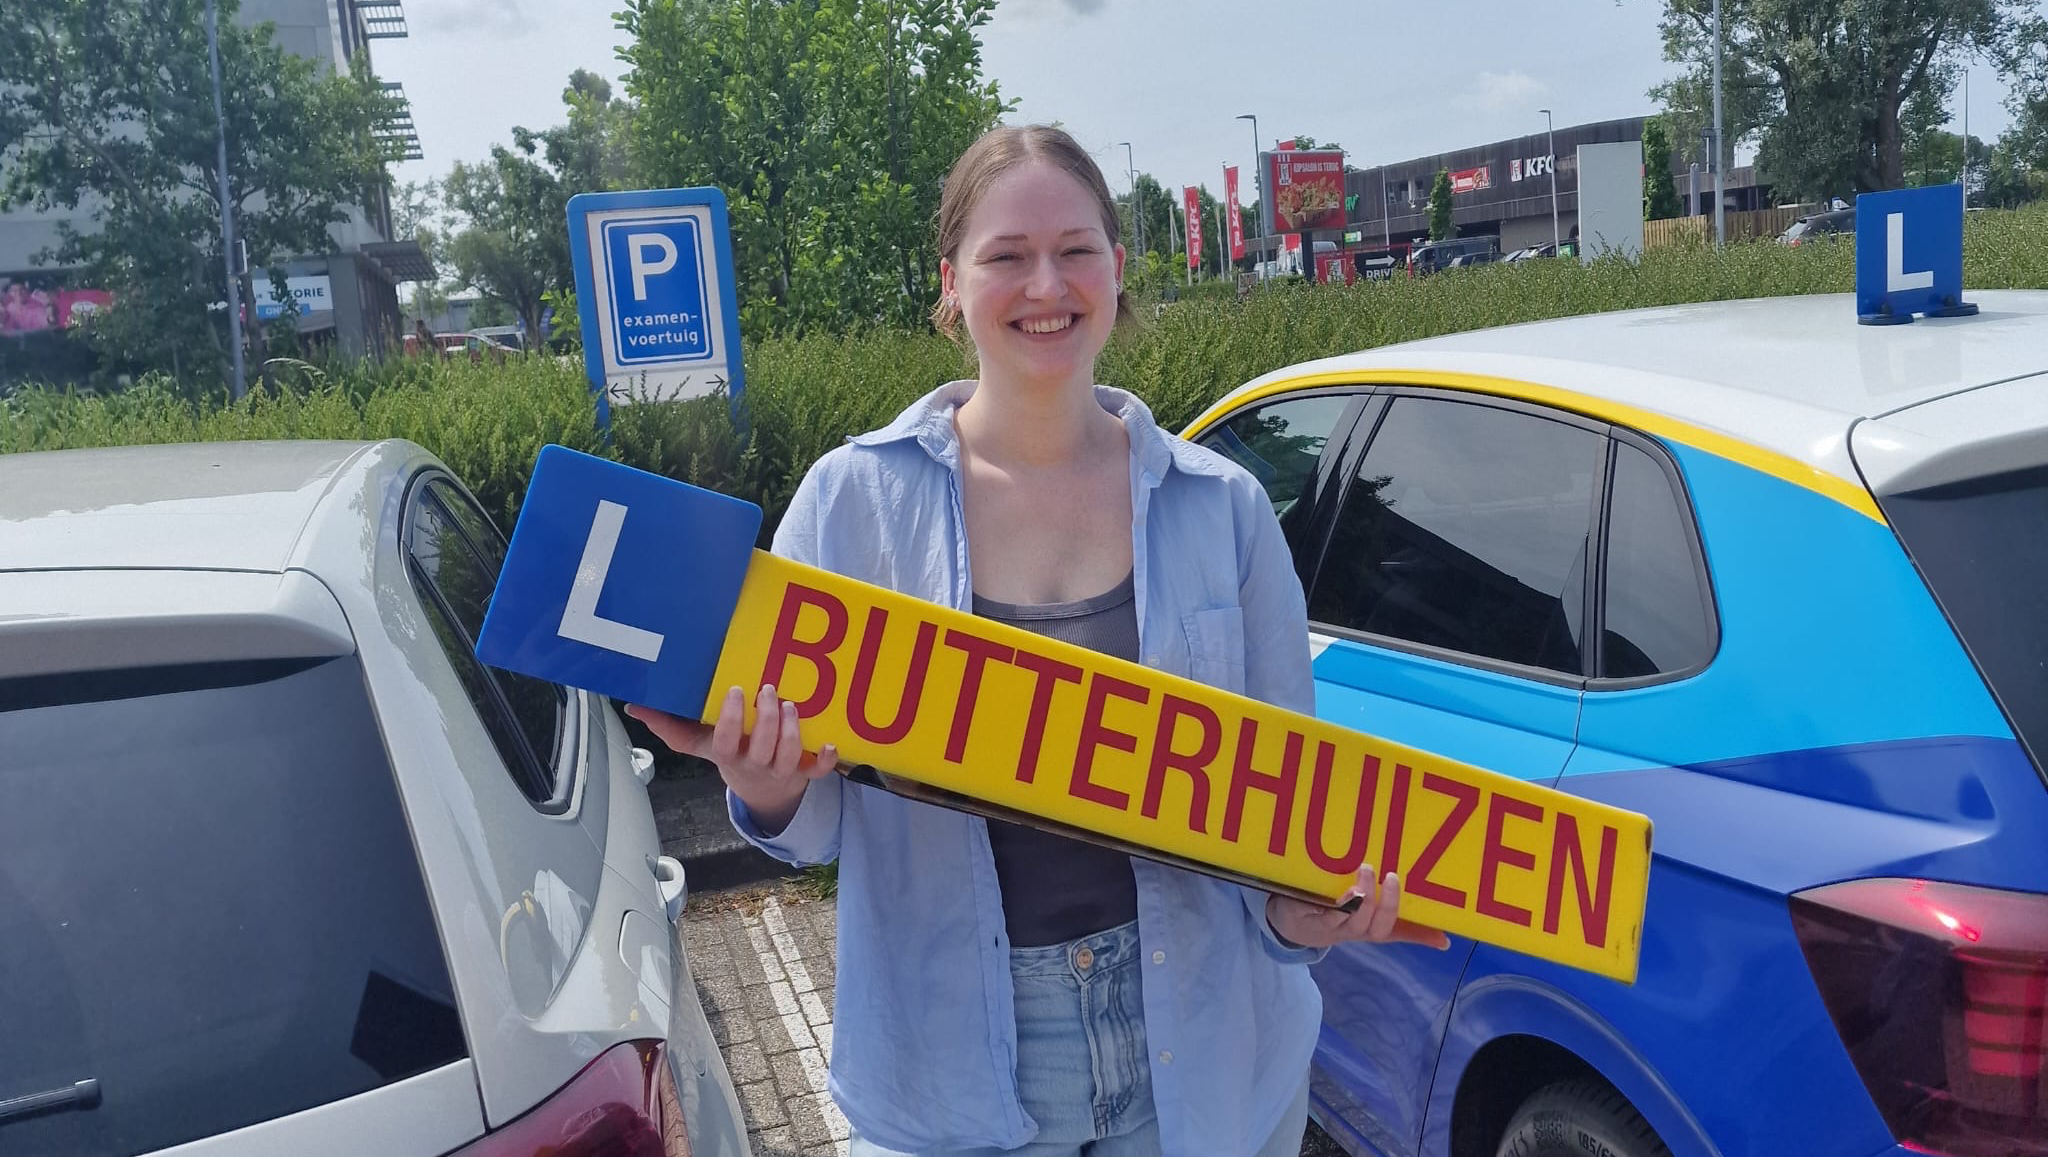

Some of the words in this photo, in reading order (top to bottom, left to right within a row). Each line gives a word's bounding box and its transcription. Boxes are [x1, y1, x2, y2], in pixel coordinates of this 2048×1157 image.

[1524, 154, 1555, 178] KFC
[1188, 201, 1201, 239] KFC
[627, 232, 678, 301] P
[1887, 212, 1934, 293] L
[268, 287, 325, 301] TEORIE
[623, 311, 698, 327] examen-
[628, 329, 699, 346] voertuig
[557, 499, 664, 662] L
[756, 582, 1618, 949] BUTTERHUIZEN
